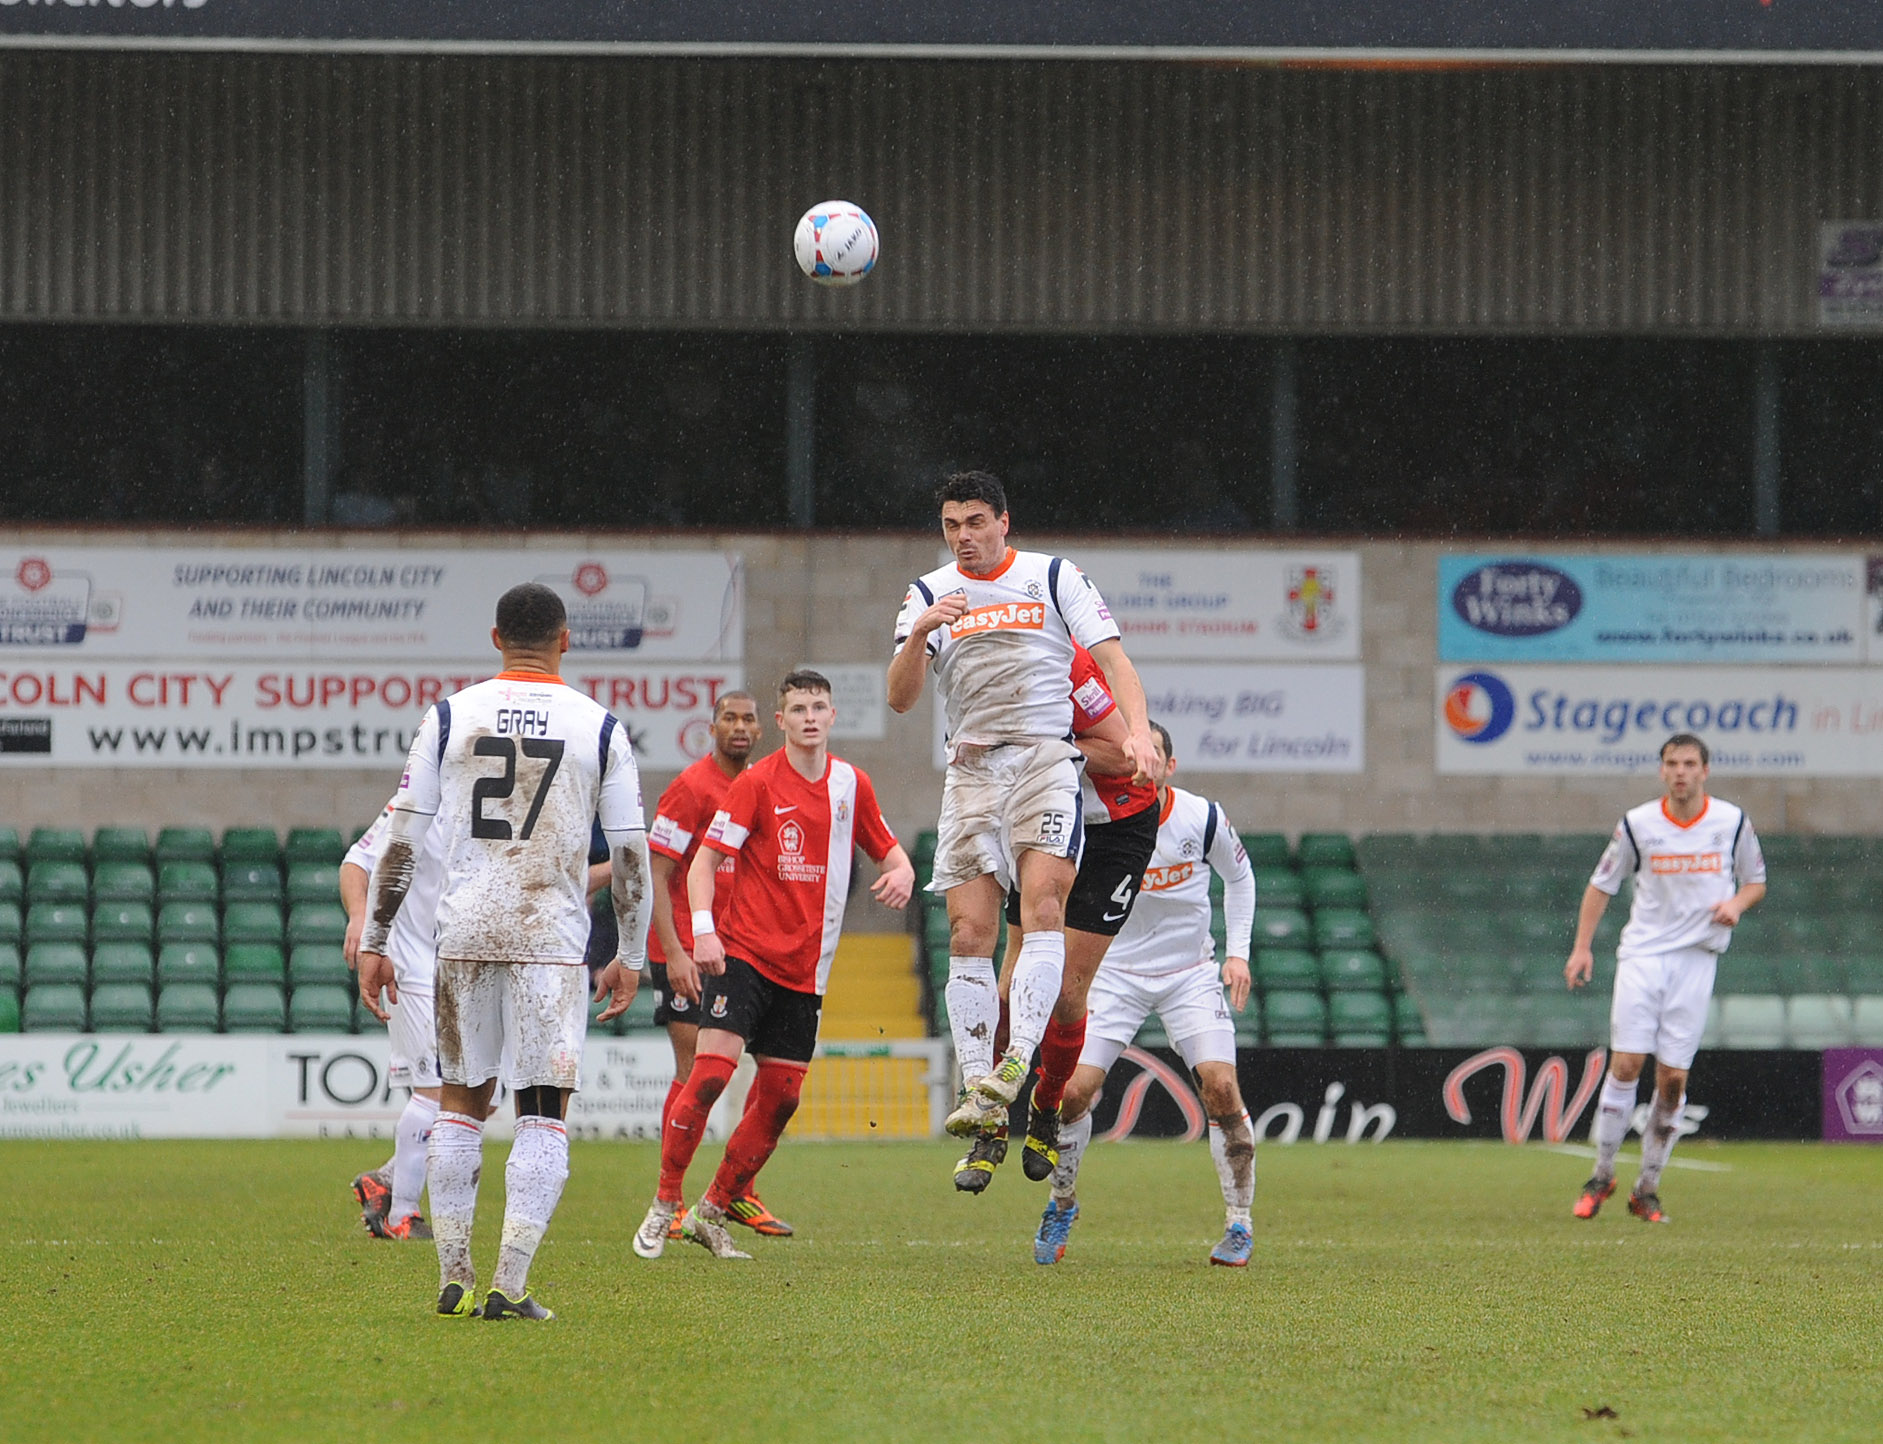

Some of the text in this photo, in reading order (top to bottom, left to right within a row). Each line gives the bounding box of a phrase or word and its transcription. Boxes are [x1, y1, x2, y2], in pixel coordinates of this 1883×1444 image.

[174, 564, 444, 589] SUPPORTING LINCOLN CITY
[190, 600, 425, 621] AND THEIR COMMUNITY
[128, 673, 233, 706] CITY
[257, 675, 494, 708] SUPPORT
[578, 676, 726, 709] TRUST
[497, 709, 549, 736] GRAY
[1523, 689, 1797, 743] Stagecoach
[471, 736, 565, 840] 27
[1041, 813, 1062, 834] 25
[1110, 874, 1132, 909] 4
[1142, 866, 1191, 890] yJet
[62, 1040, 234, 1093] Usher
